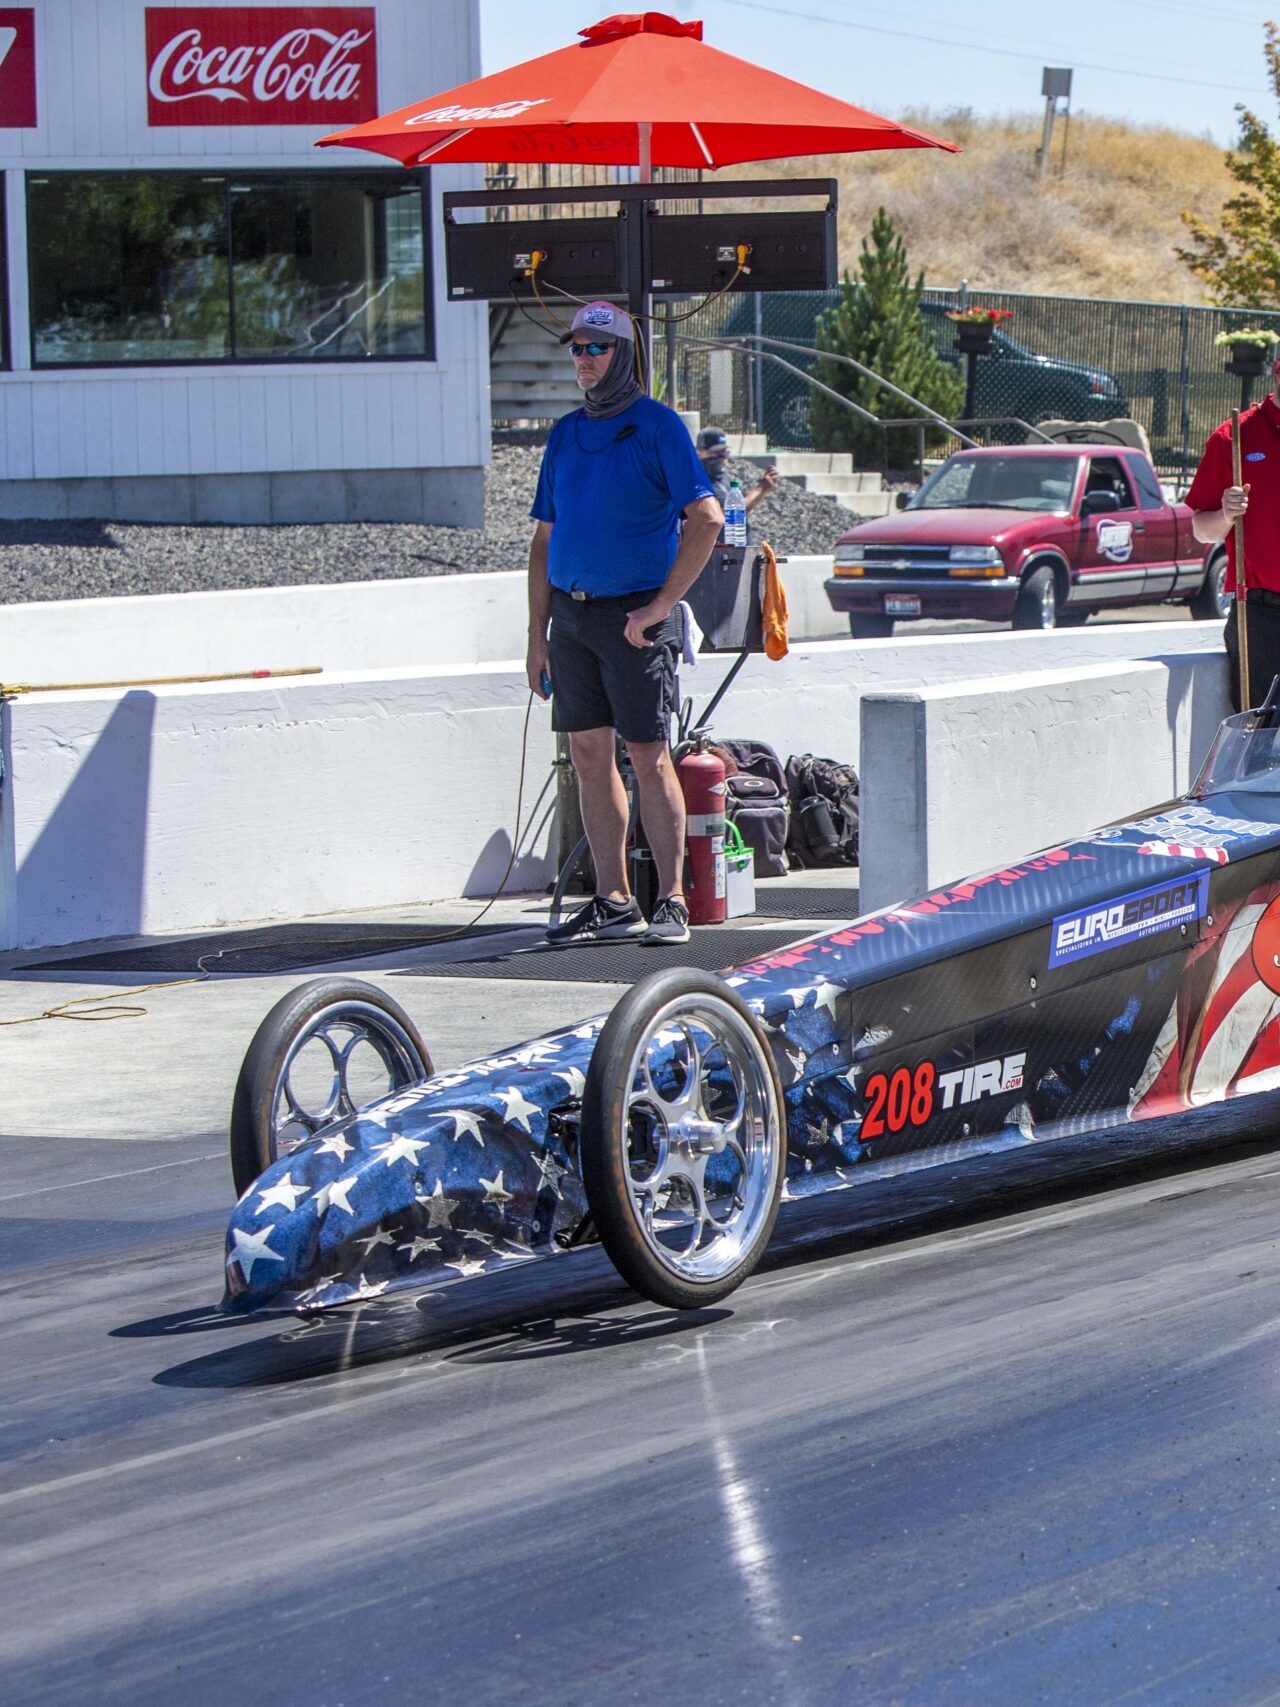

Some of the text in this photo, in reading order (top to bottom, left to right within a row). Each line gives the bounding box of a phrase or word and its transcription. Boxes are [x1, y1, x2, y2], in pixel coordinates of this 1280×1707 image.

[150, 28, 373, 103] Coca-Cola
[1055, 939, 1093, 957] SPECIALIZING
[1138, 914, 1194, 937] AUTOMOTIVE SERVICE
[859, 1052, 1028, 1140] 208 TIRE
